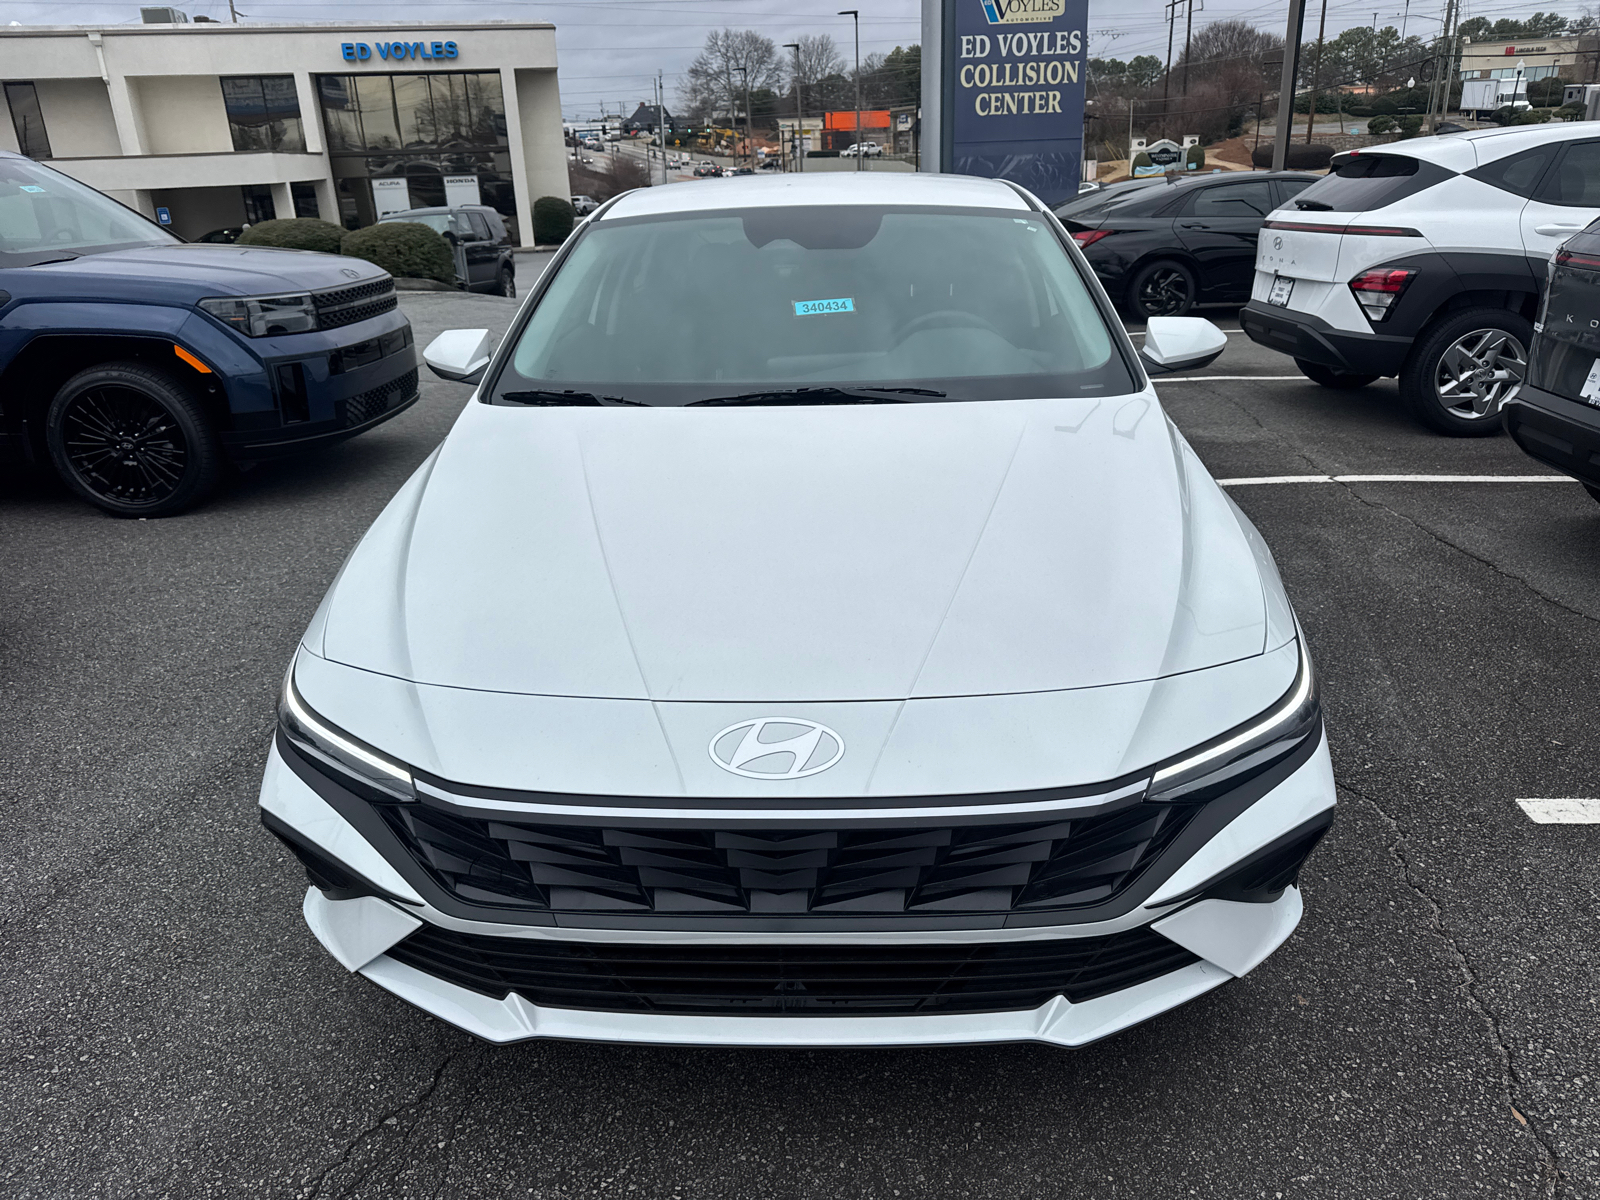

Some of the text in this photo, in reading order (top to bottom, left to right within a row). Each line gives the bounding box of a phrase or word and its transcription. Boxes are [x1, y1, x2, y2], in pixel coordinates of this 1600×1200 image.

[993, 0, 1060, 20] VOYLES
[341, 41, 459, 60] ED VOYLES
[960, 30, 1081, 58] ED VOYLES
[960, 61, 1080, 88] COLLISION
[975, 91, 1062, 116] CENTER
[802, 301, 847, 313] 340434
